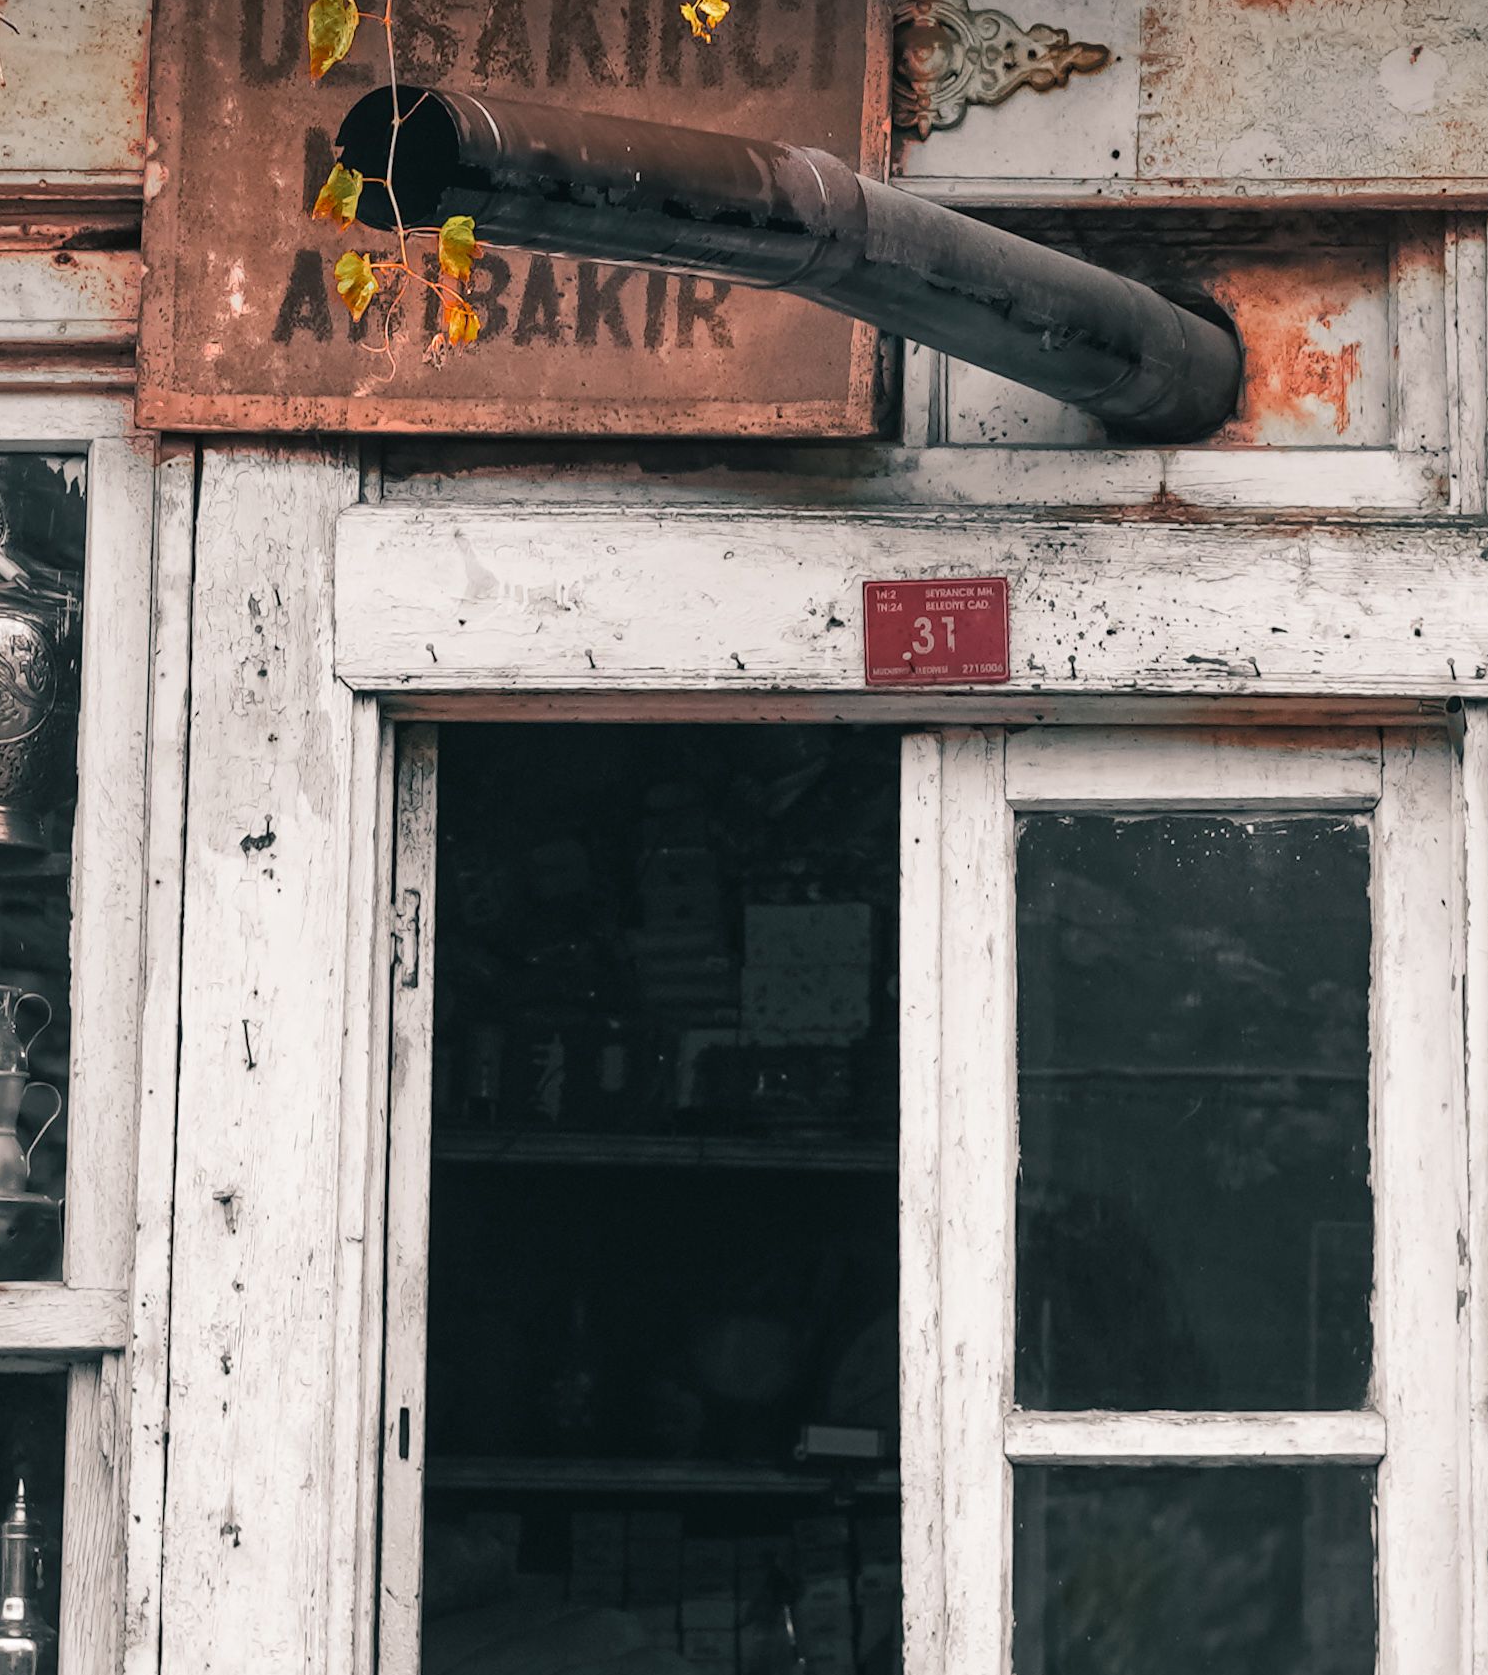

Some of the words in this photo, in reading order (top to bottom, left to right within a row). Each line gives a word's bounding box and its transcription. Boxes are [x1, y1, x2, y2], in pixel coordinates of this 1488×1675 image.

[925, 598, 965, 611] BELEDİYE
[967, 599, 991, 610] CAD.
[912, 616, 956, 655] 31
